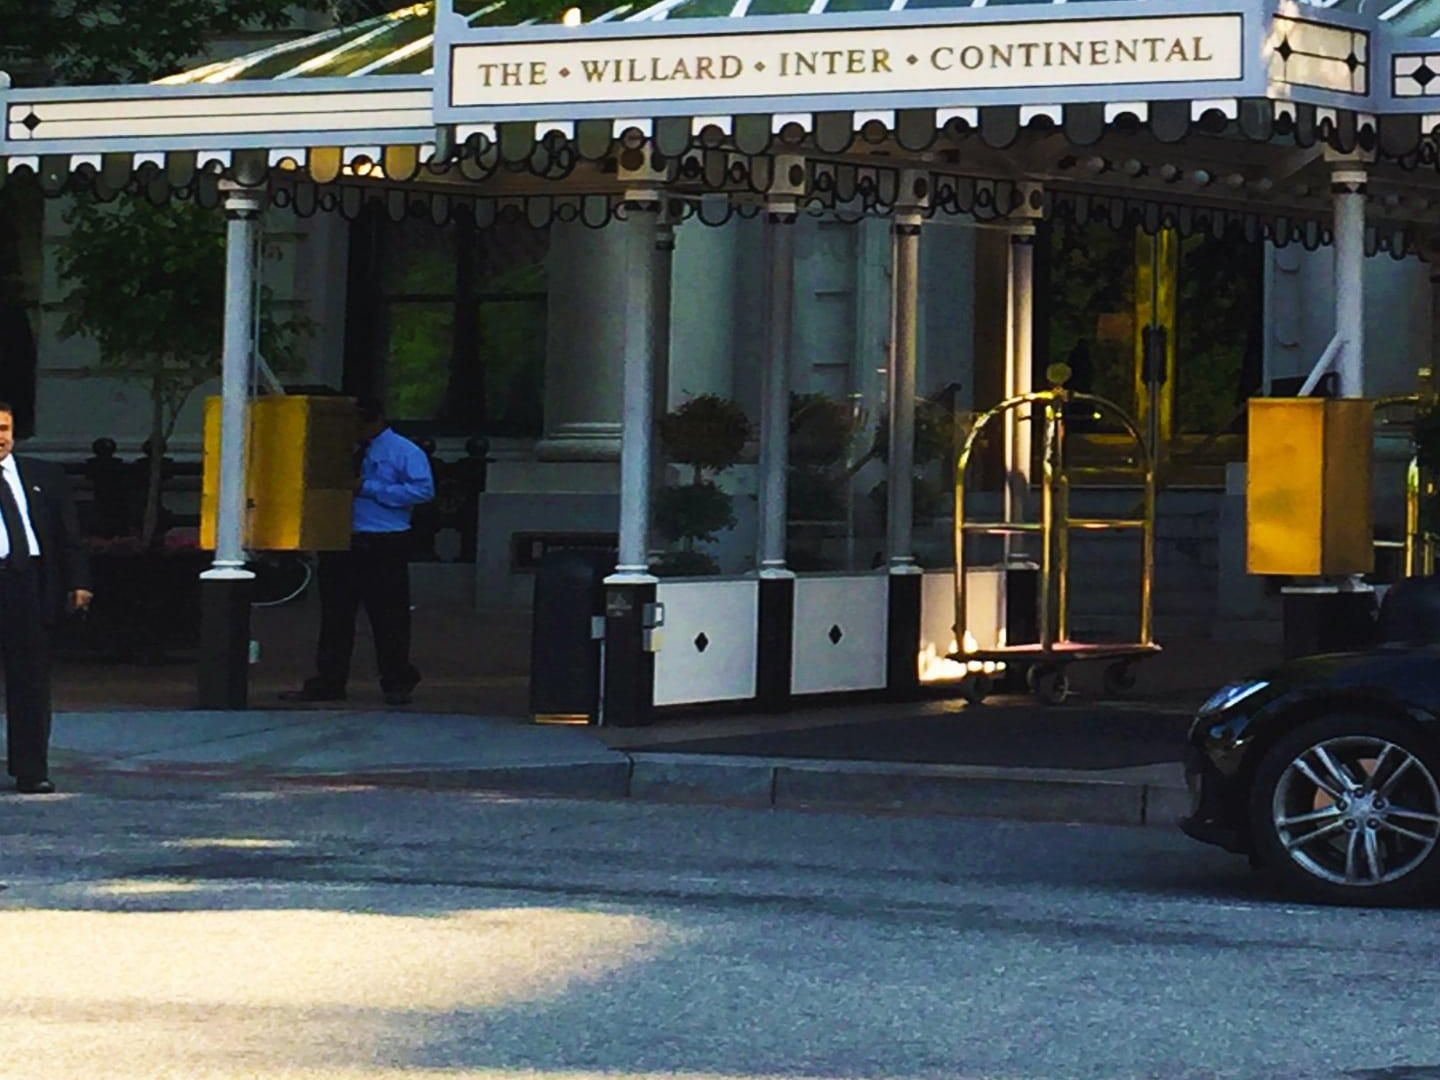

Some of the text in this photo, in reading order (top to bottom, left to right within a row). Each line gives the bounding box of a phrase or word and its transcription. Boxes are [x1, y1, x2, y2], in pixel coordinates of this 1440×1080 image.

[477, 37, 1213, 87] THE WILLARD INTER CONTINENTAL
